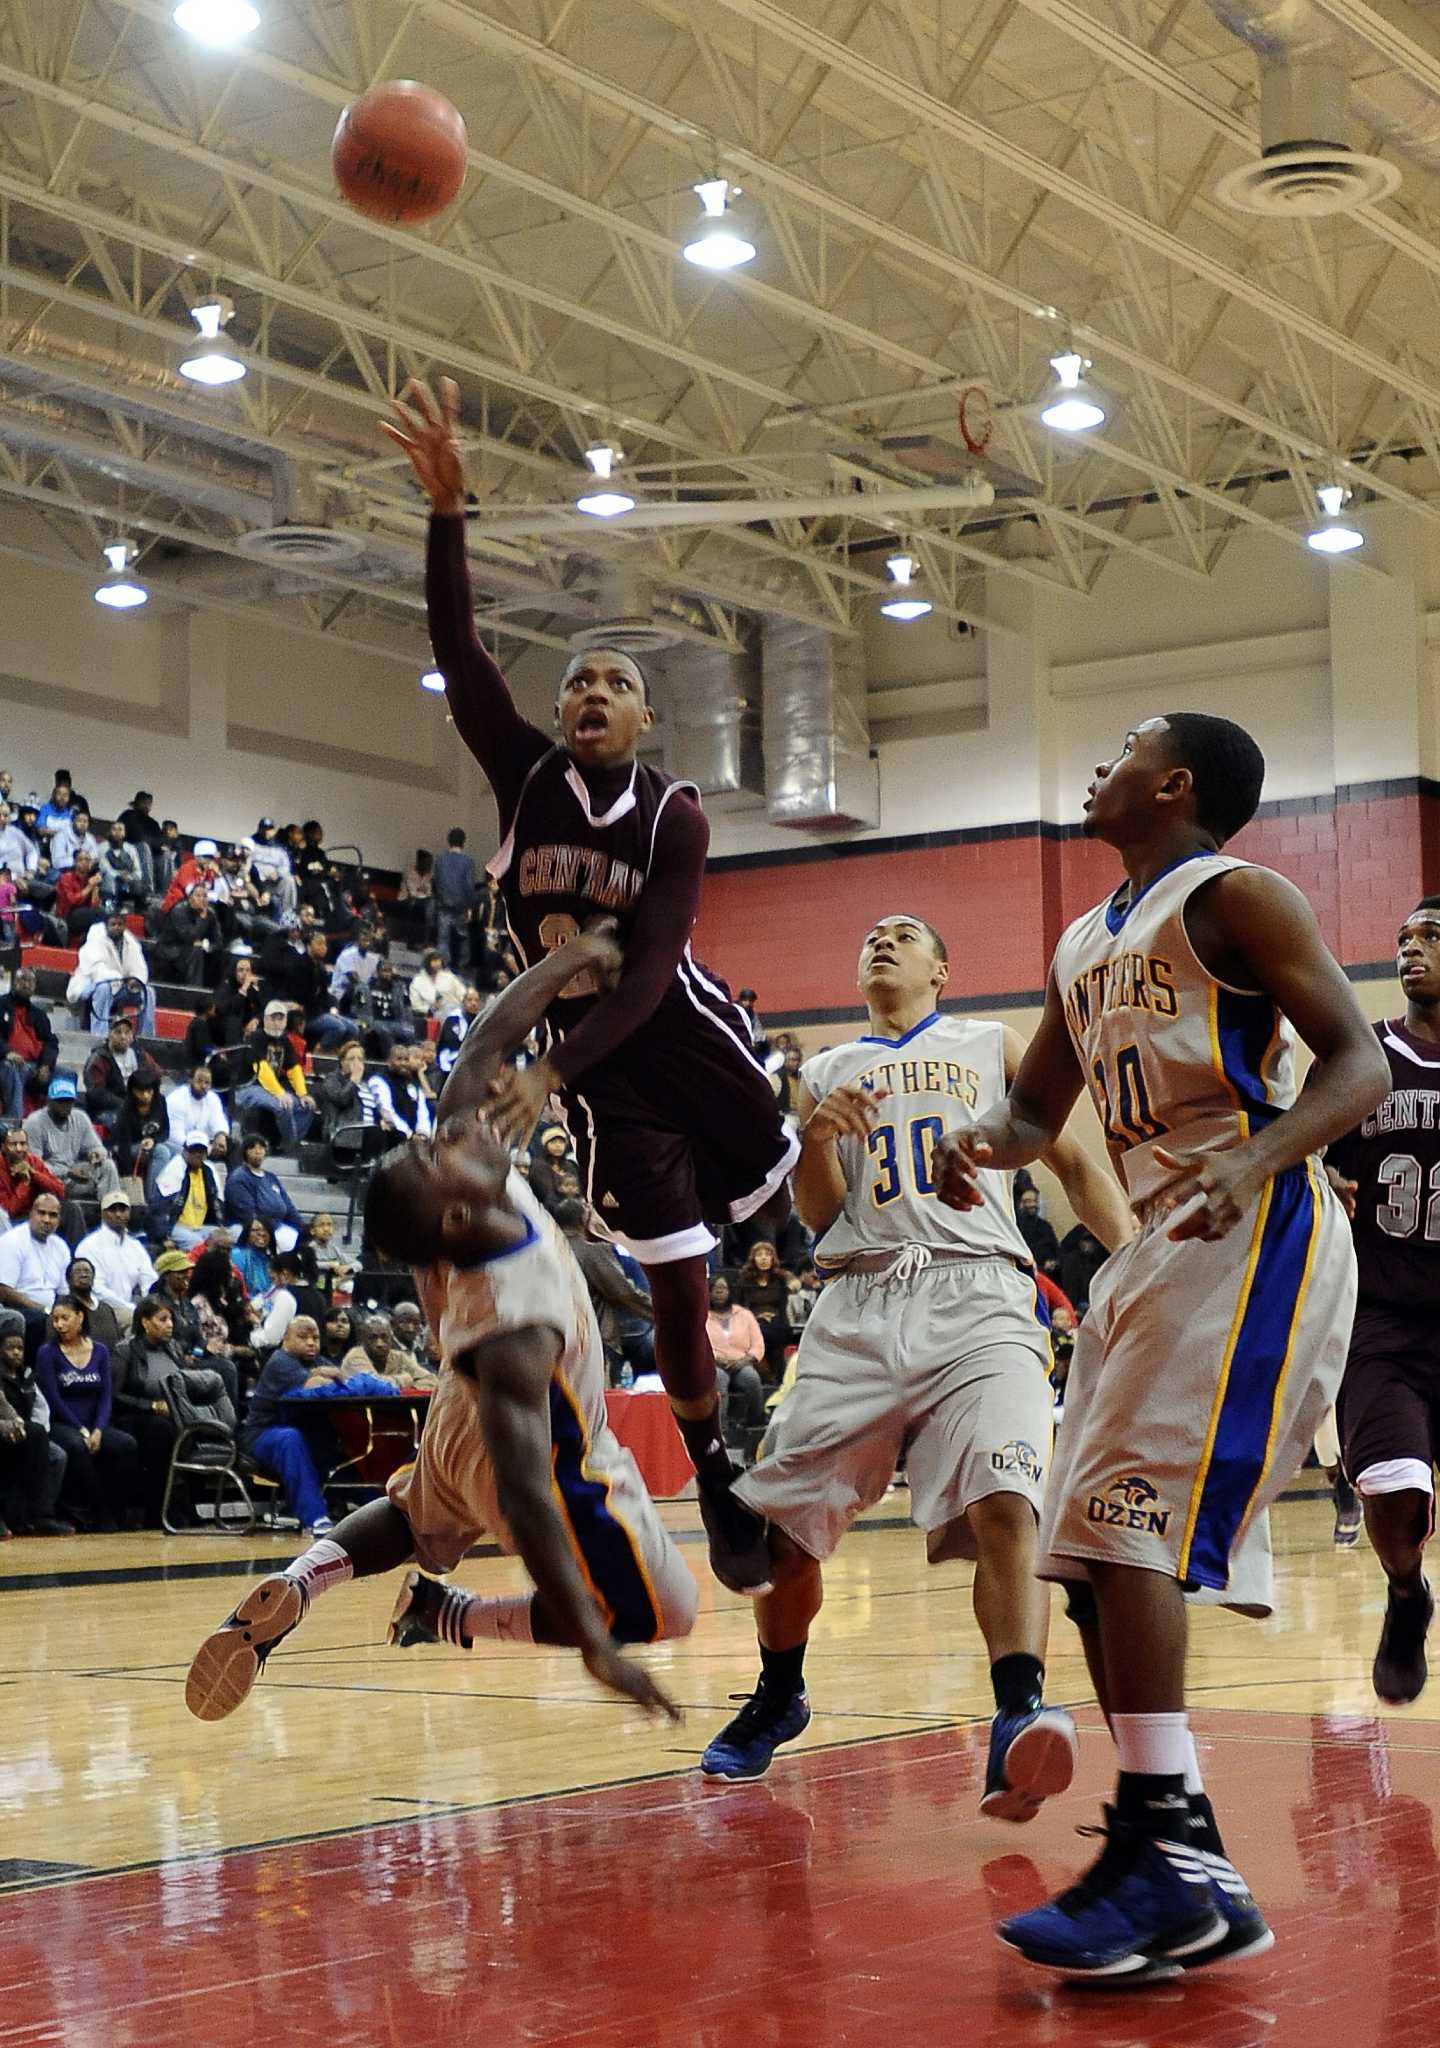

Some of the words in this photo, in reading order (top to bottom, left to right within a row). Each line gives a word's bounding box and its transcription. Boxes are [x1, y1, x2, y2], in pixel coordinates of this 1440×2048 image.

[859, 1061, 980, 1111] NTHERS
[1361, 1089, 1440, 1138] CENT
[865, 1112, 946, 1207] 30
[1088, 1496, 1171, 1537] OZEN
